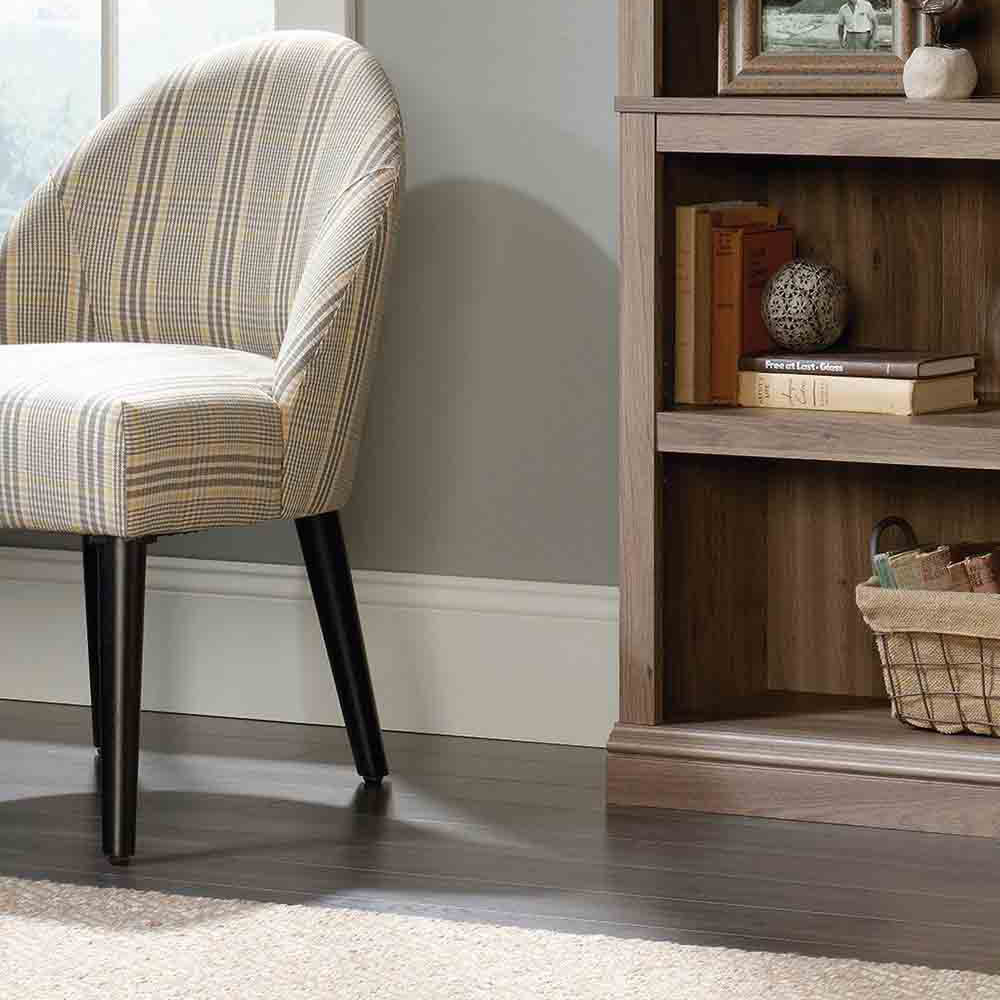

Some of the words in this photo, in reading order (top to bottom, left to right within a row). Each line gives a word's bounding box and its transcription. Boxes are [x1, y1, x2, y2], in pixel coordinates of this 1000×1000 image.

[765, 359, 784, 369] Free
[785, 361, 796, 370] at
[796, 361, 815, 371] Last
